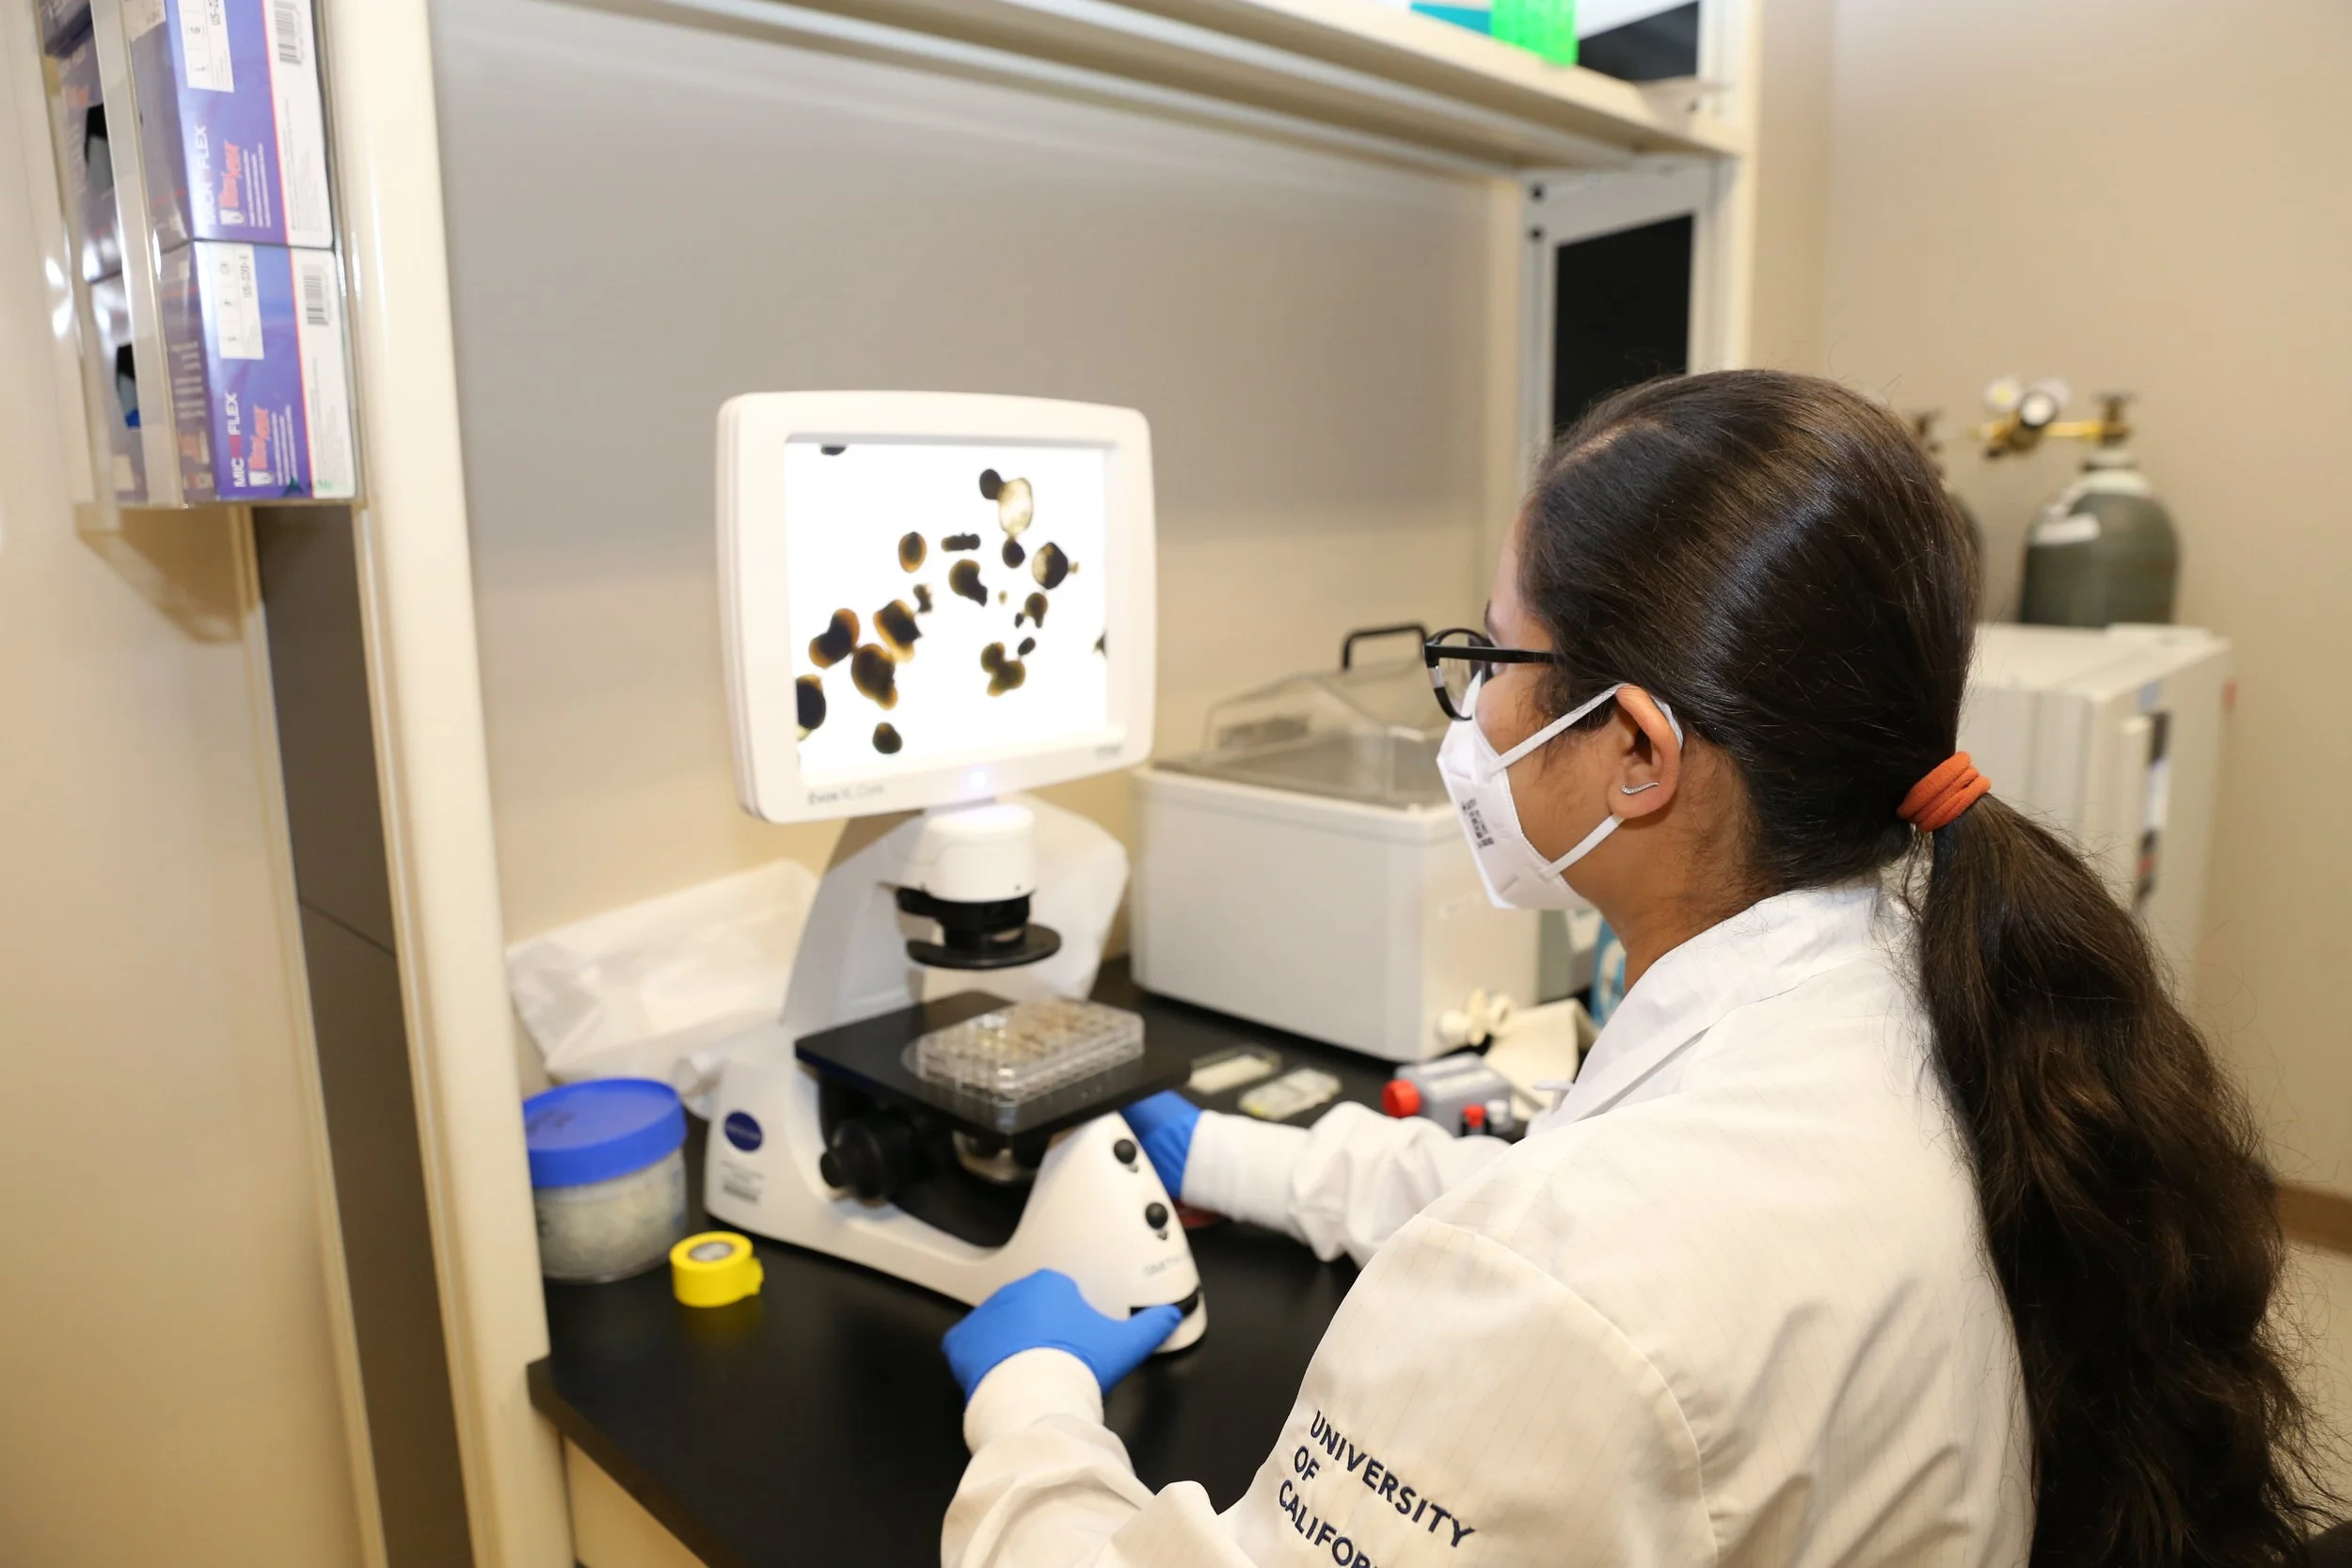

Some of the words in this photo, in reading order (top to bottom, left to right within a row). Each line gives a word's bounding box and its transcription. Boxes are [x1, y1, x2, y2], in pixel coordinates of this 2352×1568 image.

[1294, 1446, 1320, 1481] OF
[1310, 1410, 1475, 1547] UNIVERSITY
[1279, 1480, 1377, 1568] CALIFOR
